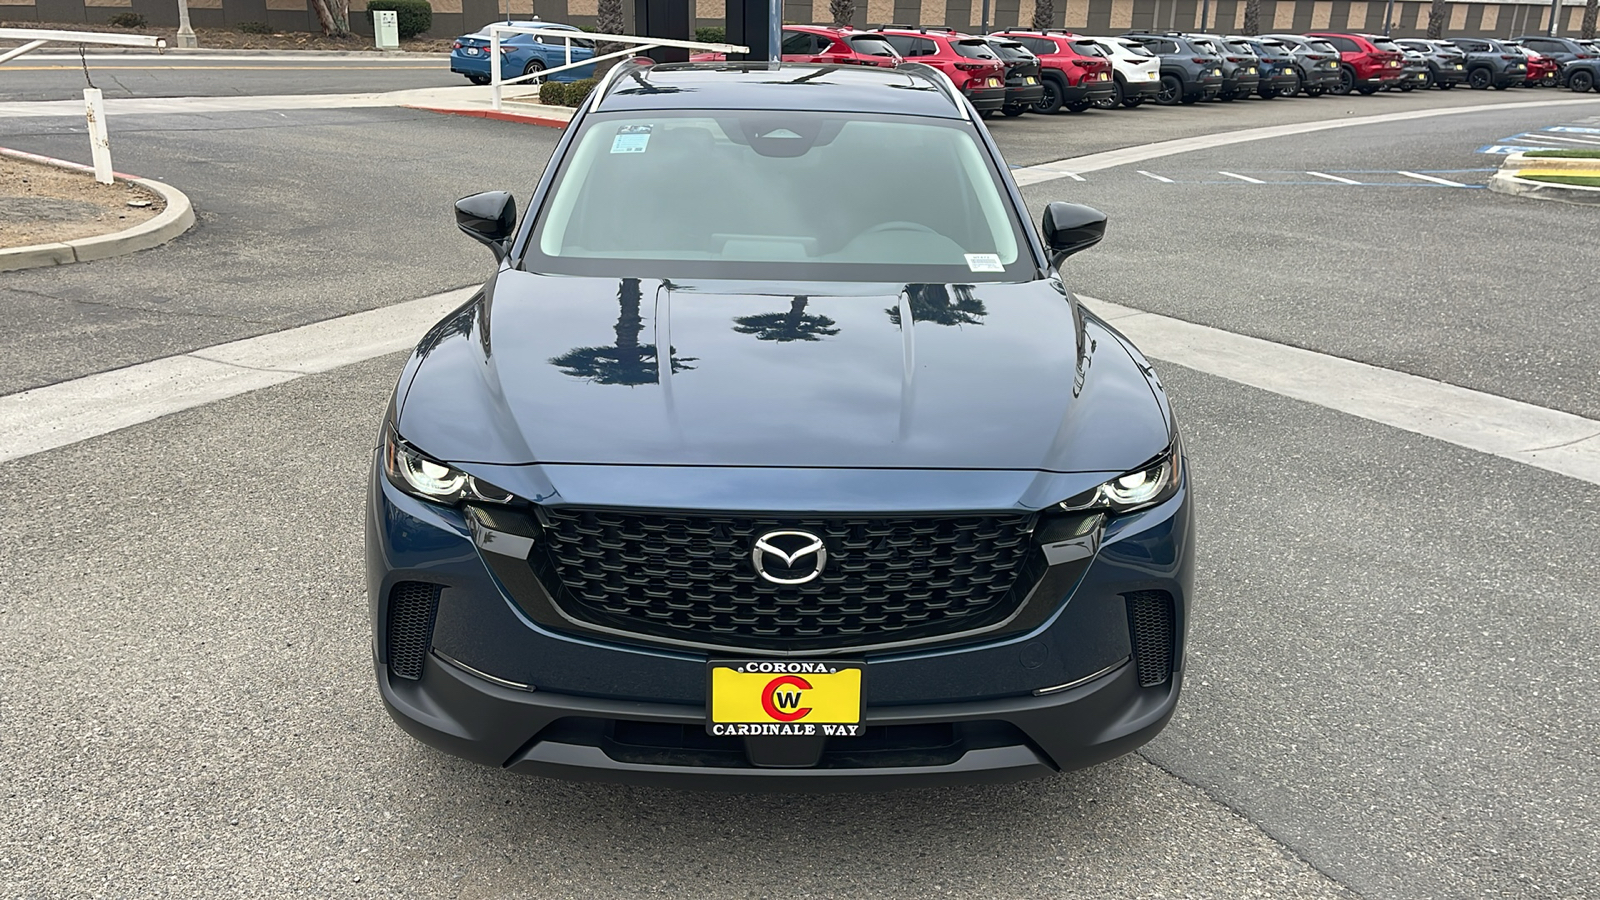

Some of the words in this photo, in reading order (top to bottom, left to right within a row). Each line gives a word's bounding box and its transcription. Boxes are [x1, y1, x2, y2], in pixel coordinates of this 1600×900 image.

[745, 662, 828, 673] CORONA
[712, 724, 816, 736] CARDINALE
[822, 724, 860, 736] WAY
